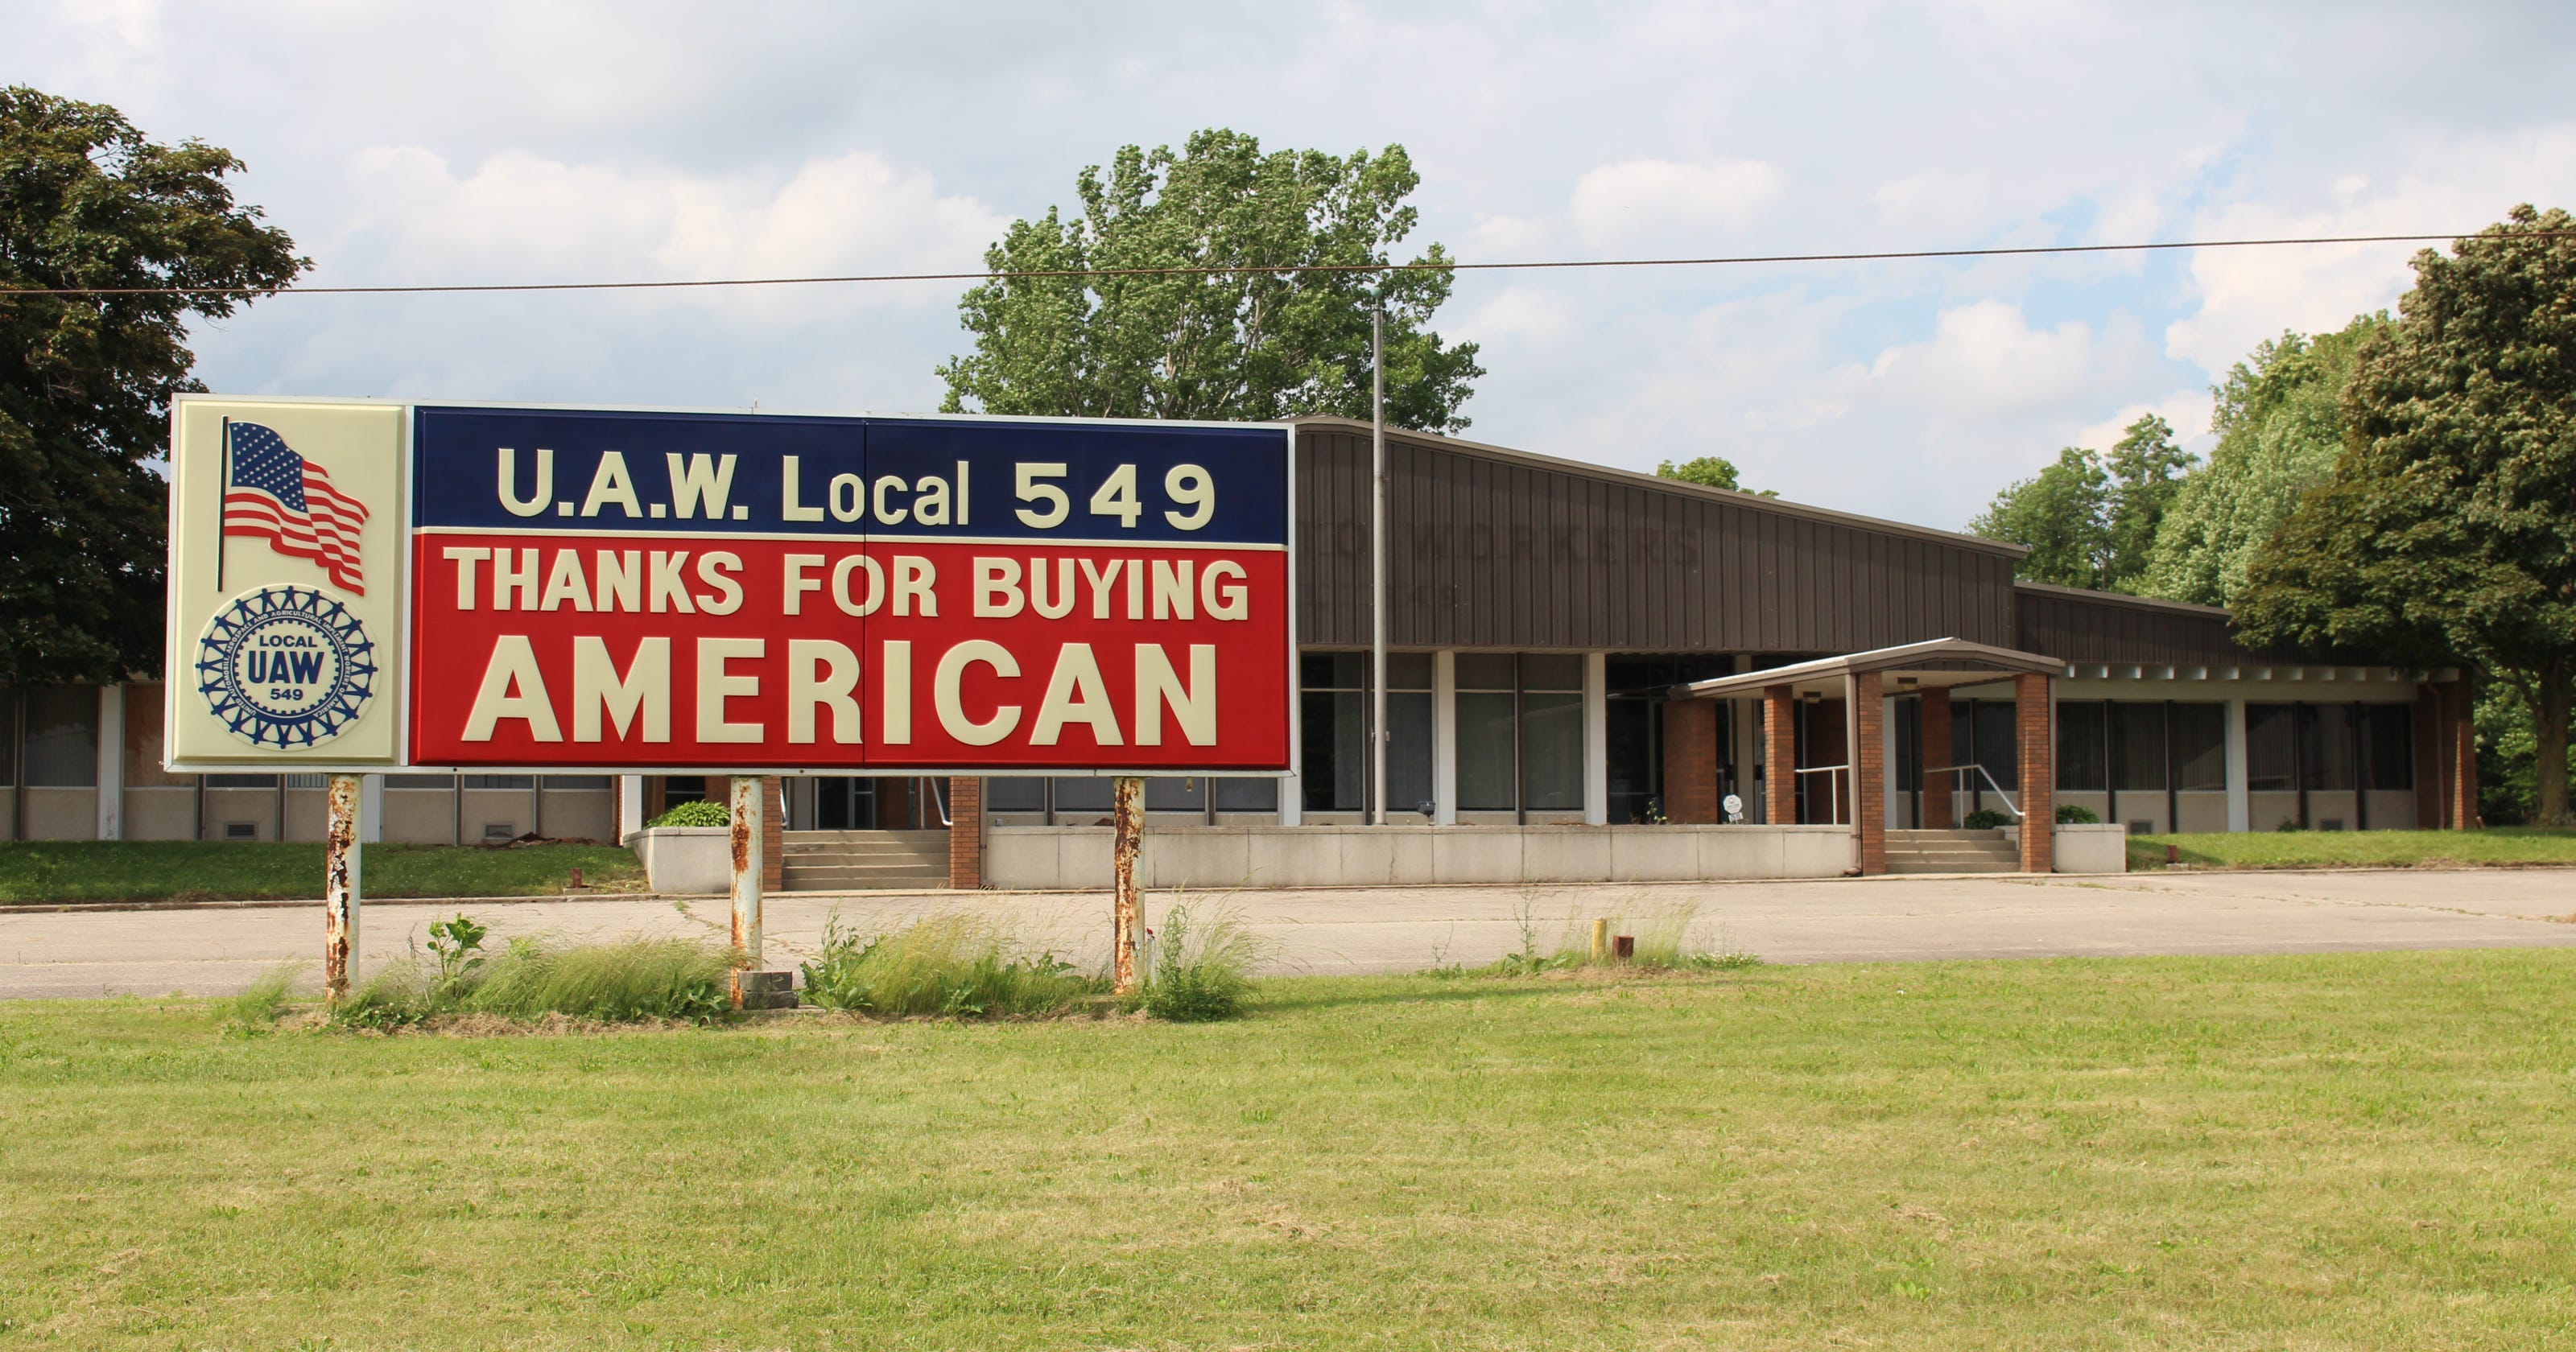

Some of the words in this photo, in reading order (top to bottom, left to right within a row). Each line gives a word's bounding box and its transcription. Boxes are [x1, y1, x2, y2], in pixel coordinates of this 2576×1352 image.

[498, 447, 748, 520] U.A.W.
[782, 455, 969, 526] Local
[1014, 462, 1216, 530] 549
[443, 546, 744, 616] THANKS
[783, 553, 939, 617] FOR
[973, 556, 1249, 621] BUYING
[254, 613, 269, 624] AND
[271, 610, 322, 624] AGRICULTURAL
[259, 635, 318, 647] LOCAL
[322, 621, 349, 653] IMPLEMENT
[248, 650, 325, 684] UAW
[342, 655, 351, 686] WORKERS
[270, 688, 303, 700] 549
[460, 634, 1217, 747] AMERICAN
[235, 698, 257, 716] UNITED
[315, 696, 339, 717] AMERICA
